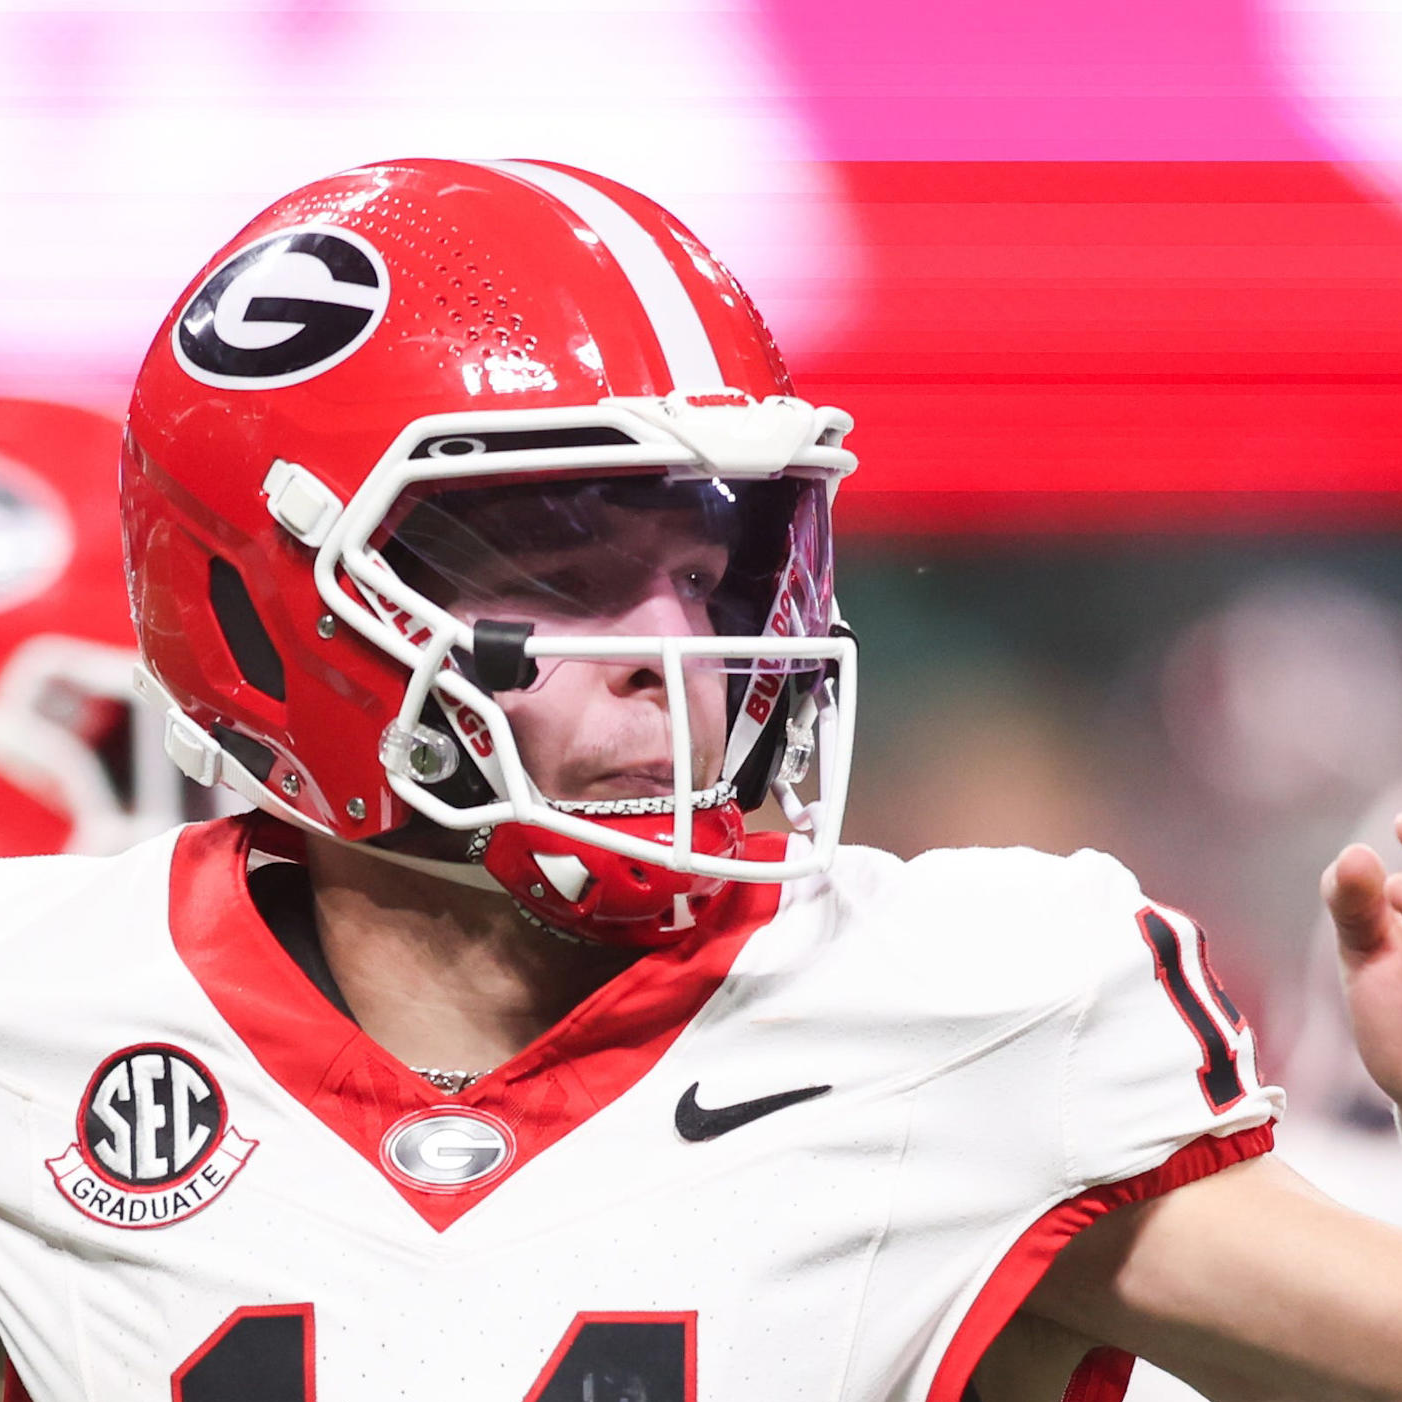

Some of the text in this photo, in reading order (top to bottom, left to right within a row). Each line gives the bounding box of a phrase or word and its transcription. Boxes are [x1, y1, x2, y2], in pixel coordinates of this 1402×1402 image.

[177, 229, 383, 379] G
[90, 1052, 212, 1182] SEC
[394, 1114, 507, 1183] G
[71, 1162, 227, 1223] GRADUATE
